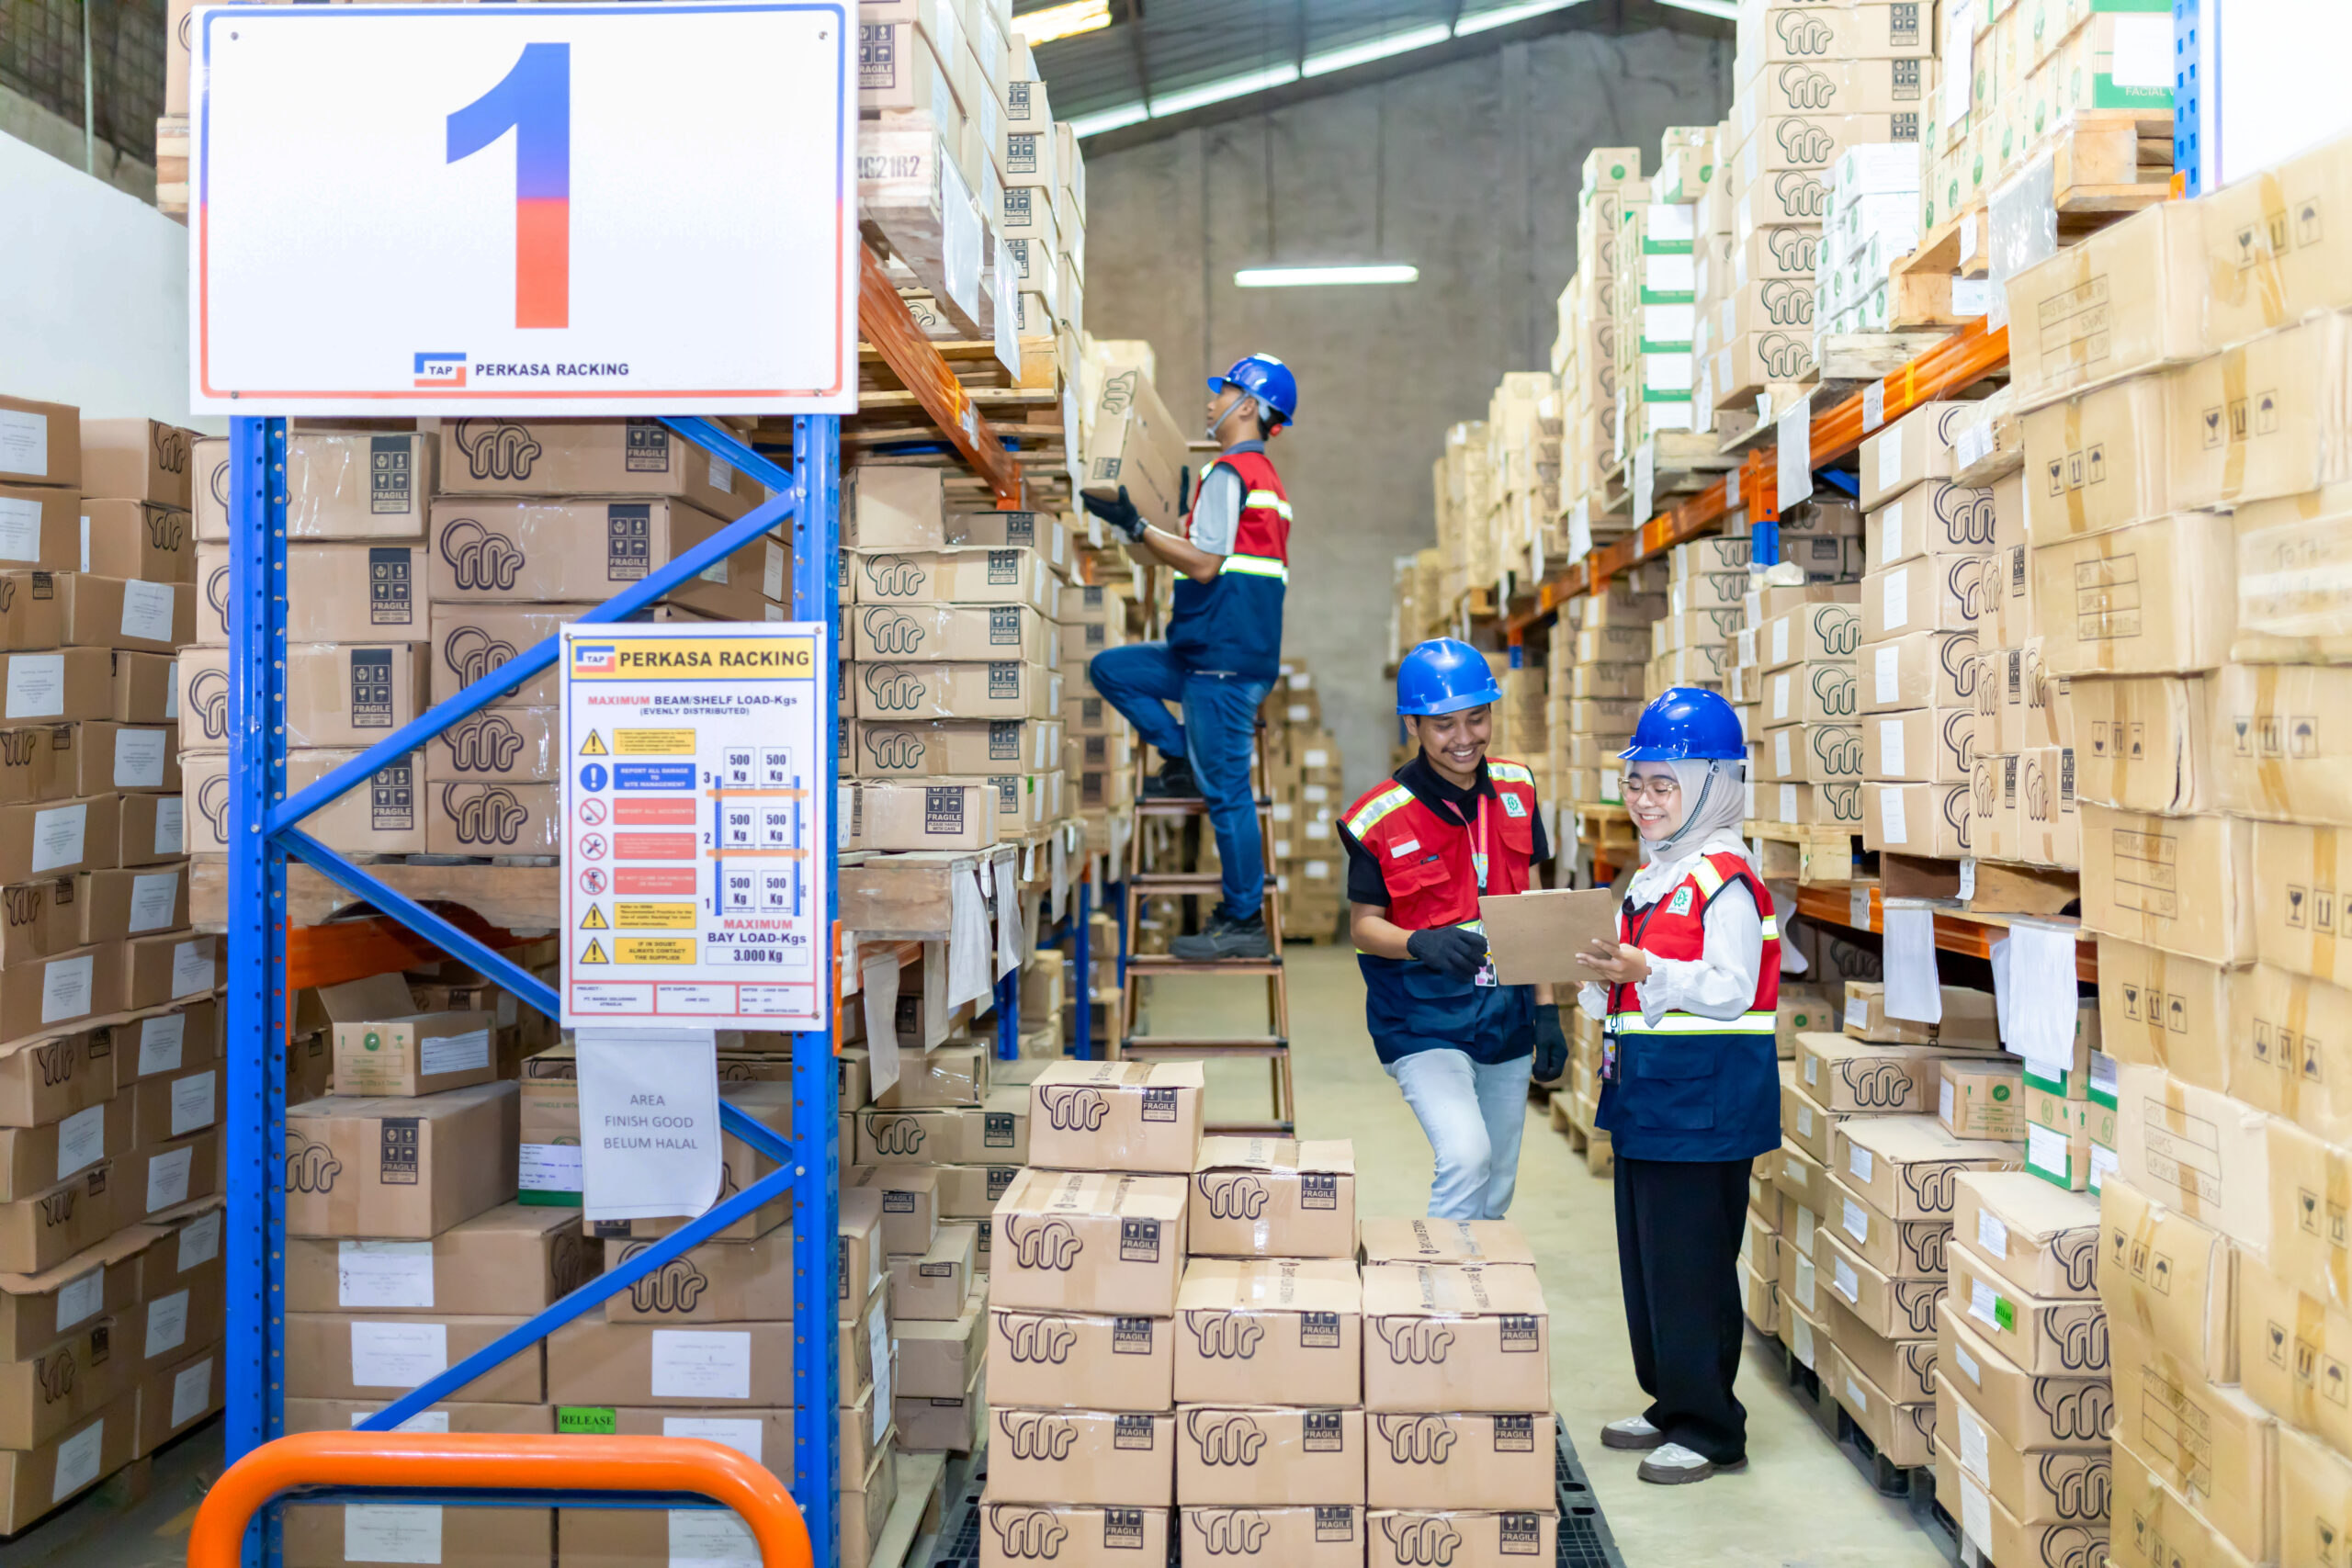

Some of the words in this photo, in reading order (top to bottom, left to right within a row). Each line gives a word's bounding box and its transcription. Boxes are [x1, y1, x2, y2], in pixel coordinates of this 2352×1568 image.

[859, 64, 892, 73] RAGILE
[2125, 86, 2166, 96] FACIAL
[447, 42, 570, 328] 1
[429, 366, 453, 375] TAP
[475, 364, 550, 376] PERKASA
[556, 364, 629, 376] RACKING
[628, 449, 666, 457] FRAGILE
[373, 491, 409, 500] FRAGILE
[609, 558, 648, 567] FRAGILE
[372, 602, 410, 610] FRAGILE
[620, 652, 712, 667] PERKASA
[719, 651, 809, 666] RACKING
[588, 696, 650, 705] MAXIMUM
[654, 695, 733, 705] BEAM/SHELF
[737, 695, 797, 706] LOAD-Kgs
[353, 705, 390, 713] FRAGILE
[640, 707, 679, 716] (EVENLY
[683, 707, 750, 716] DISTRIBUTED)
[729, 754, 750, 765] 500
[766, 754, 786, 765] 500
[704, 772, 710, 784] 3
[733, 770, 747, 782] Kg
[770, 770, 783, 782] Kg
[373, 807, 412, 816] FRAGILE
[729, 815, 750, 825] 500
[766, 815, 786, 825] 500
[704, 832, 710, 844] 2
[733, 830, 747, 841] Kg
[770, 830, 783, 841] Kg
[729, 878, 750, 888] 500
[766, 878, 786, 888] 500
[705, 897, 710, 908] 1
[733, 894, 747, 905] Kg
[770, 894, 783, 905] Kg
[724, 919, 793, 929] MAXIMUM
[707, 933, 735, 942] BAY
[740, 933, 807, 945] LOAD-Kgs
[733, 950, 765, 962] 3.000
[768, 950, 783, 963] Kg
[630, 1095, 665, 1106] AREA
[605, 1116, 648, 1127] FINISH
[652, 1116, 694, 1128] GOOD
[604, 1137, 651, 1149] BELUM
[656, 1138, 698, 1149] HALAL
[382, 1163, 416, 1171] FRAGILE
[1303, 1190, 1335, 1198] FRAGILE
[1122, 1240, 1158, 1249] FRAGILE
[1302, 1325, 1338, 1335] FRAGILE
[1501, 1330, 1537, 1339] FRAGILE
[1114, 1333, 1150, 1341] FRAGILE
[561, 1416, 614, 1427] RELEASE
[1116, 1428, 1151, 1437] FRAGILE
[1305, 1430, 1340, 1438] FRAGILE
[1495, 1429, 1532, 1438] FRAGILE
[1317, 1520, 1352, 1529] FRAGILE
[1106, 1527, 1142, 1535] FRAGILE
[1501, 1532, 1538, 1541] FRAGILE
